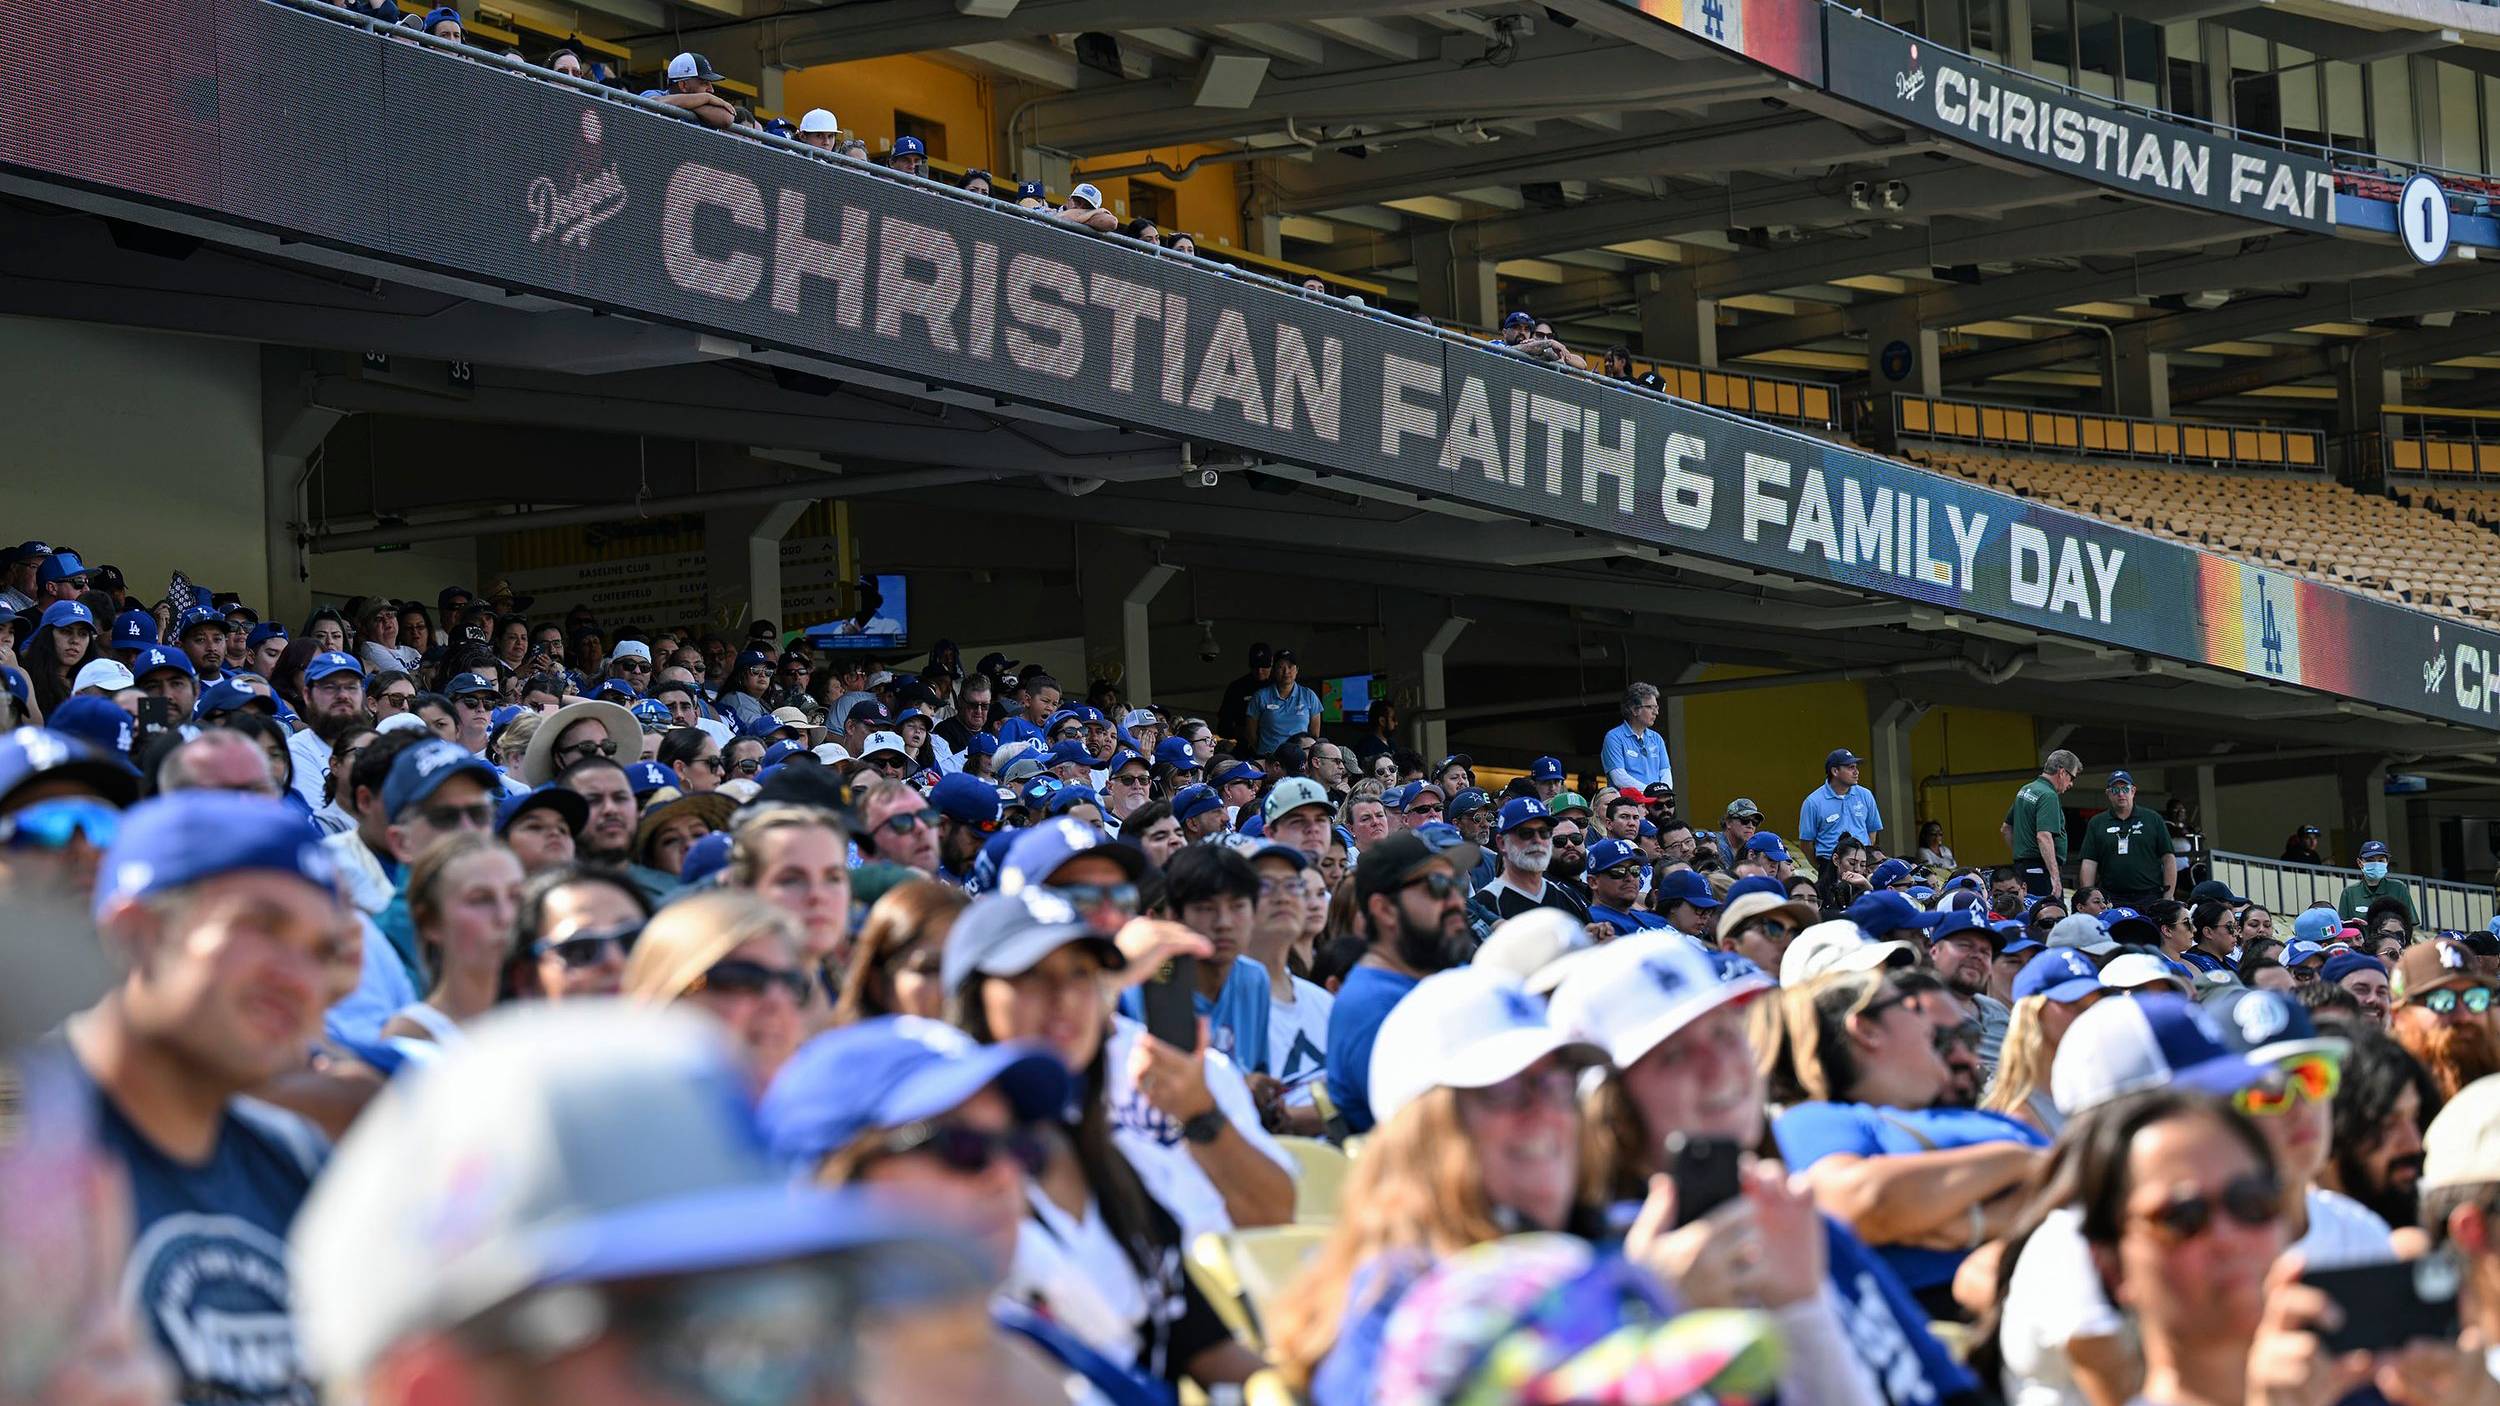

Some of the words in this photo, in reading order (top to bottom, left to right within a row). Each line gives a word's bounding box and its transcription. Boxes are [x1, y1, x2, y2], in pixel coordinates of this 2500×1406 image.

[1702, 0, 1725, 41] A
[1895, 66, 1926, 102] Dodgers
[1935, 66, 2210, 196] CHRISTIAN
[908, 139, 917, 150] LA
[2421, 197, 2434, 243] 1
[452, 360, 470, 381] 35
[662, 161, 1344, 442] CHRISTIAN
[1381, 353, 1637, 514] FAITH
[1661, 432, 1715, 531] &
[1743, 451, 1990, 591] FAMILY
[2009, 522, 2126, 625] DAY
[579, 566, 622, 578] BASELINE
[626, 563, 650, 574] CLUB
[592, 587, 652, 602] CENTERFIELD
[72, 602, 84, 615] LA
[629, 614, 656, 624] AREA
[2257, 574, 2283, 675] LA
[129, 620, 140, 635] LA
[150, 648, 166, 664] LA
[331, 652, 347, 665] LA
[473, 674, 486, 686] LA
[2455, 644, 2500, 713] CH
[1089, 708, 1097, 720] LA
[783, 739, 799, 751] LA
[874, 733, 884, 744] LA
[1124, 750, 1136, 759] LA
[647, 763, 664, 784] LA
[1548, 761, 1556, 772] LA
[1298, 783, 1313, 799] LA
[1524, 798, 1539, 814] LA
[1614, 840, 1629, 855] LA
[2118, 908, 2132, 918] LA
